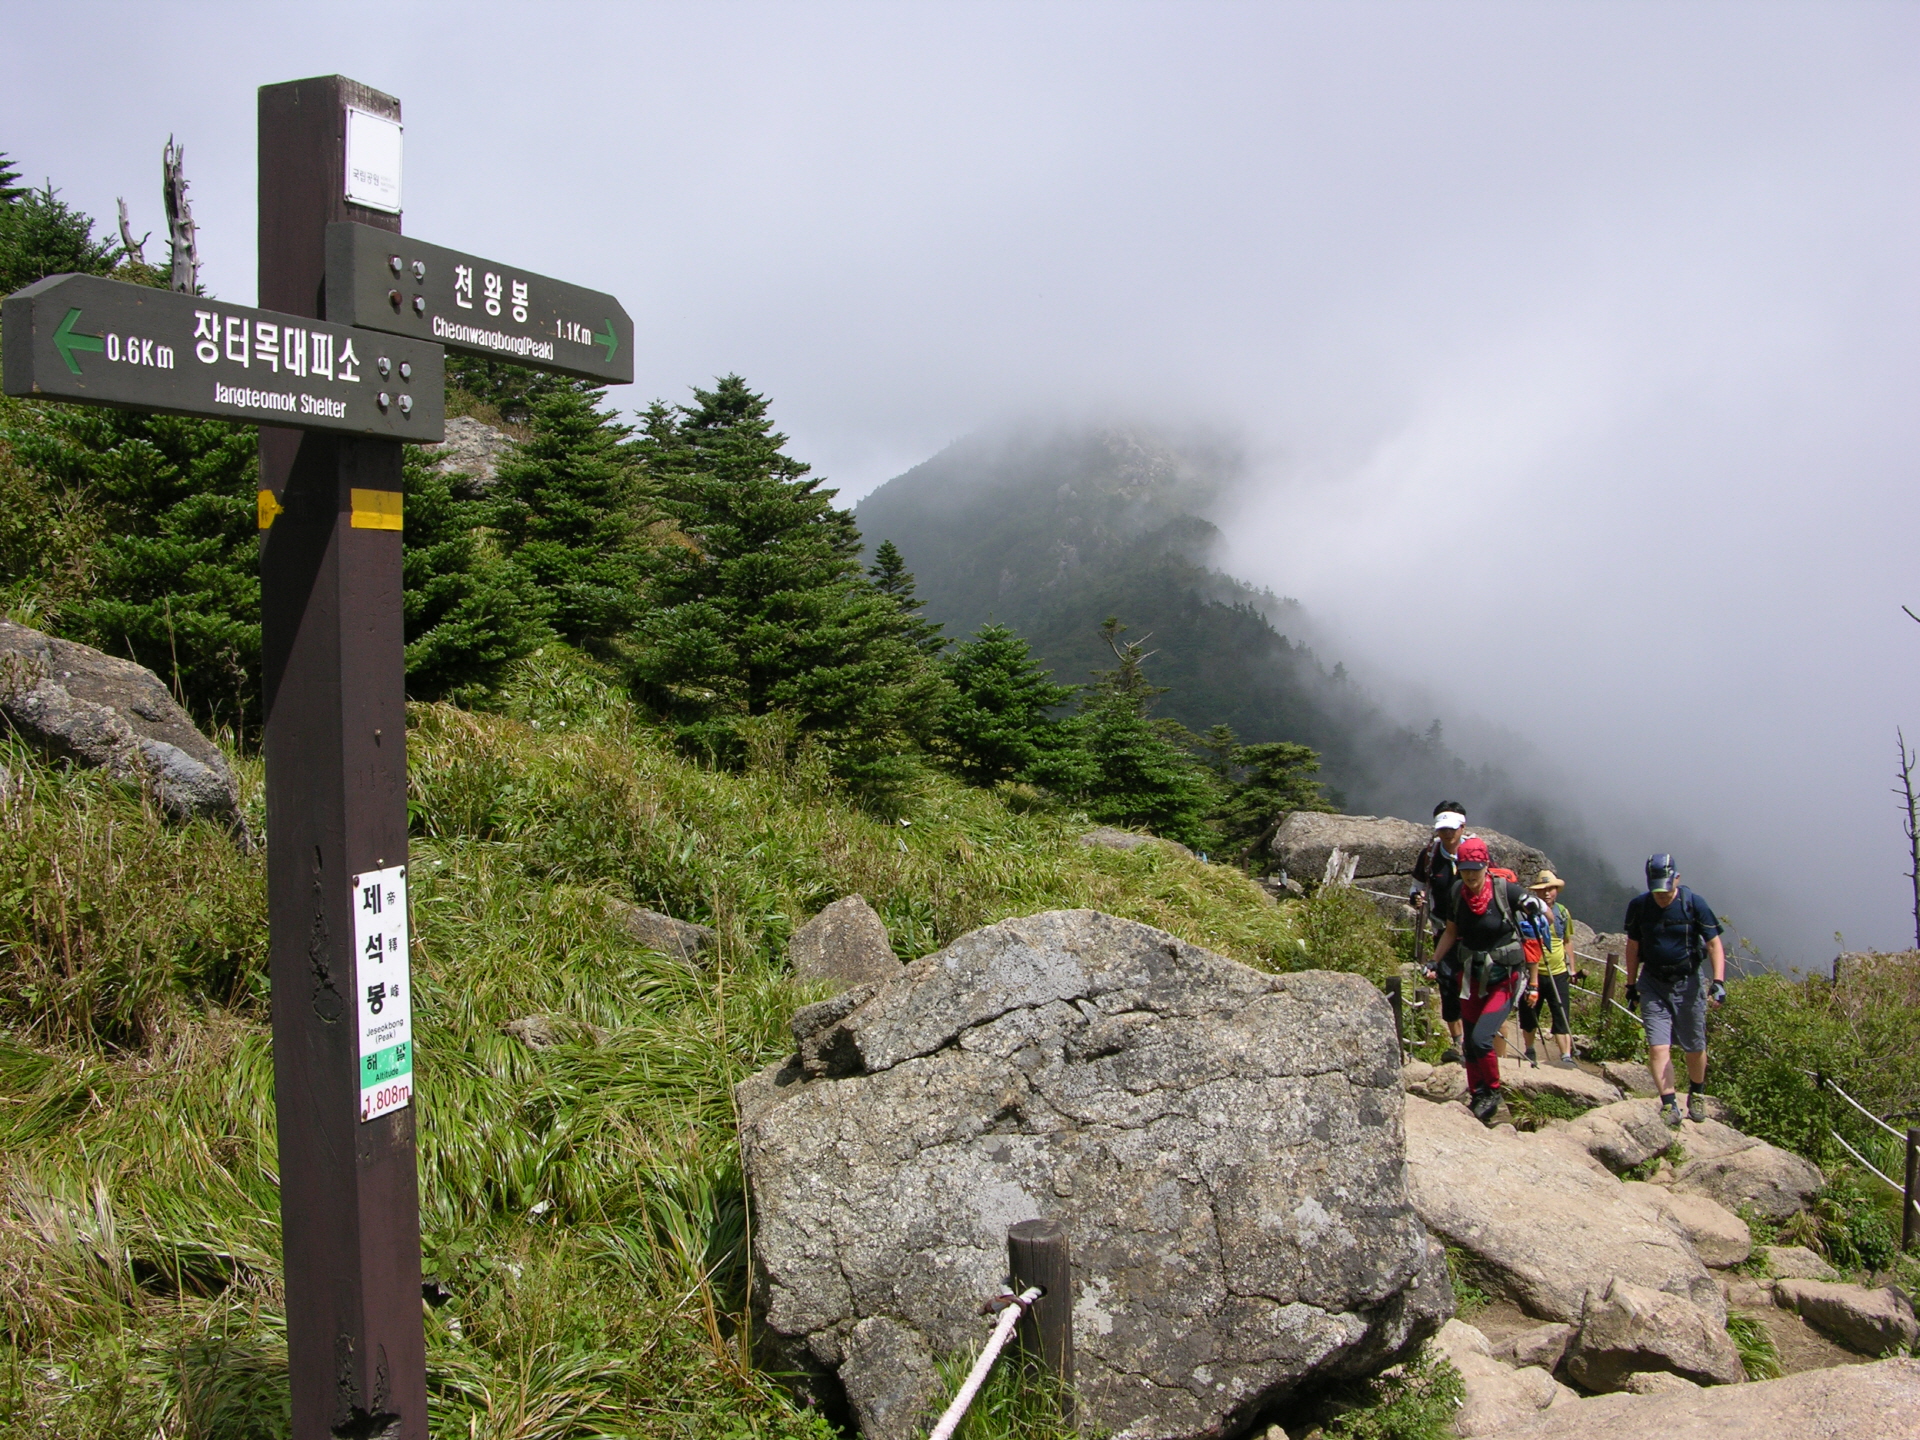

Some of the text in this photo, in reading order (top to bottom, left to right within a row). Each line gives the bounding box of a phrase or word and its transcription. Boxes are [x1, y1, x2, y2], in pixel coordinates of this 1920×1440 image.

[454, 264, 529, 323] 천왕봉
[193, 309, 361, 383] 장터목대피소
[556, 318, 592, 346] 1.1Km
[106, 332, 174, 369] 0.6Km
[214, 382, 347, 419] Jangteomok Shelter
[362, 883, 386, 1015] 제석봉
[366, 1018, 404, 1037] Jeseokbong
[375, 1029, 396, 1045] (Peak)
[375, 1067, 399, 1083] Altitude
[365, 1084, 410, 1115] 1,808m
